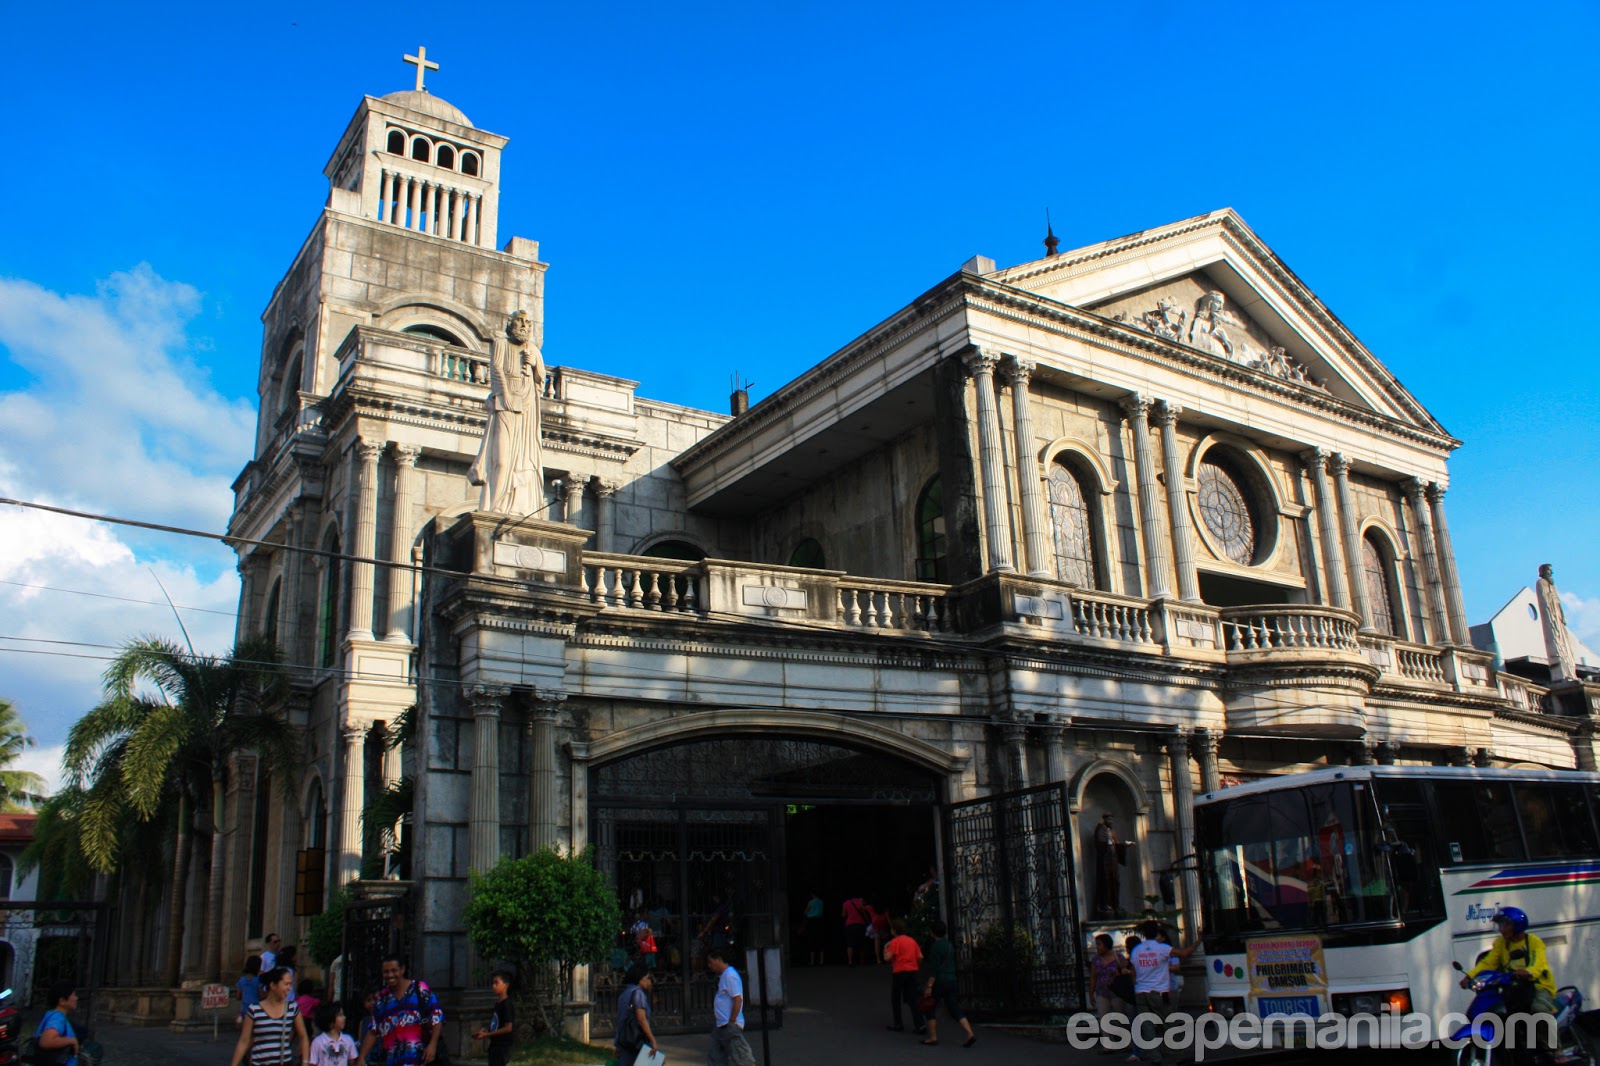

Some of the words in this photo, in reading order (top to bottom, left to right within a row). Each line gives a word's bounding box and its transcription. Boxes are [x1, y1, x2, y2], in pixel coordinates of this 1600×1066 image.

[1139, 959, 1158, 967] RESCUE
[1256, 963, 1316, 975] PHILGRIMAGE
[1268, 975, 1308, 987] CAMSUR
[208, 985, 224, 995] NO
[203, 996, 228, 1006] PARKING
[1263, 999, 1313, 1016] TOURIST
